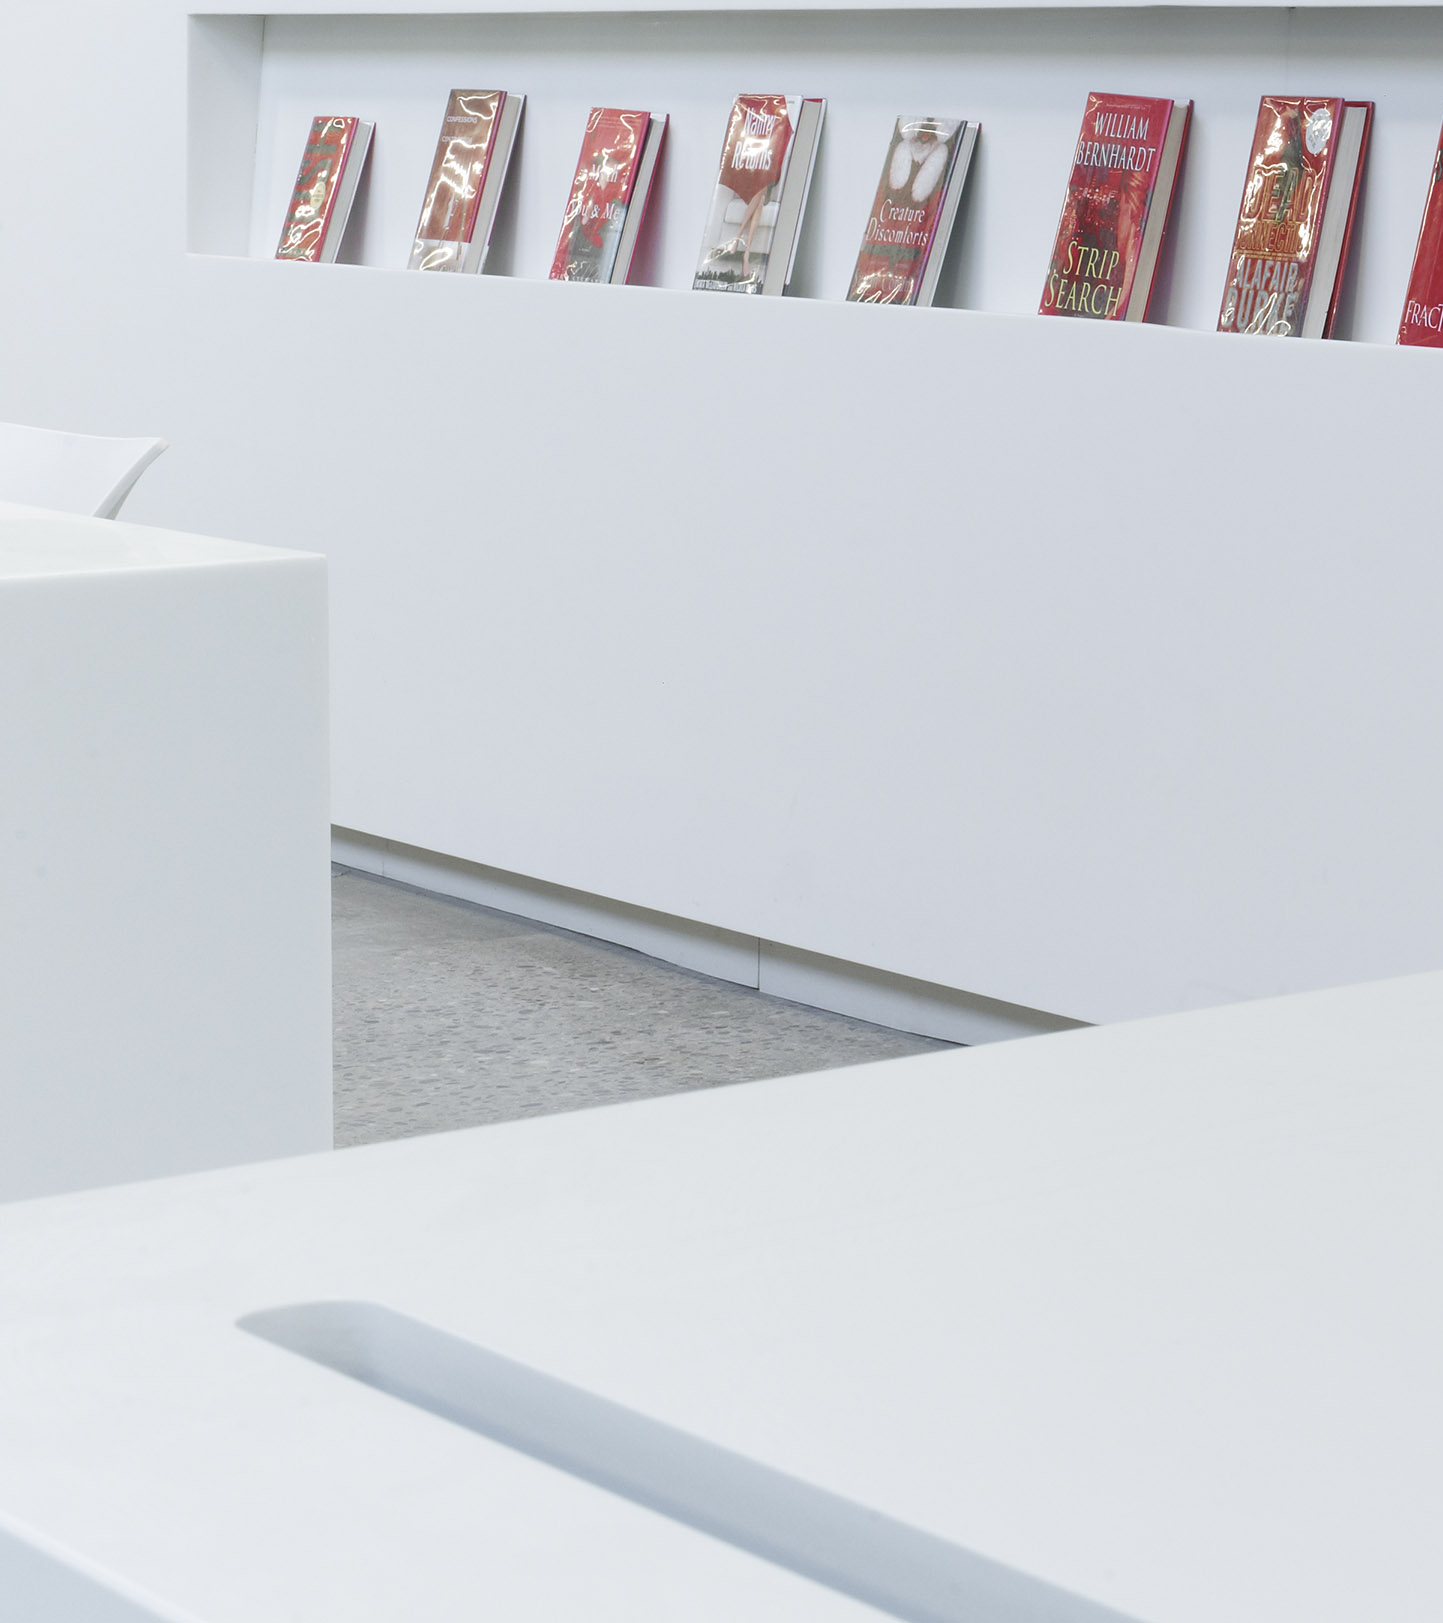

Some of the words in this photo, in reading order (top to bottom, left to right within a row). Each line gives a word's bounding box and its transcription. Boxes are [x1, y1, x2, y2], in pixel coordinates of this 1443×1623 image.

[1094, 112, 1149, 140] WILLIAM
[1076, 141, 1156, 172] BERNHARDT
[880, 199, 925, 224] Creature
[866, 217, 929, 246] Discomforts
[1063, 241, 1120, 280] STRIP
[1233, 258, 1299, 293] ALAFAIR
[1045, 274, 1123, 316] SEARCH
[1221, 287, 1299, 335] BURKE
